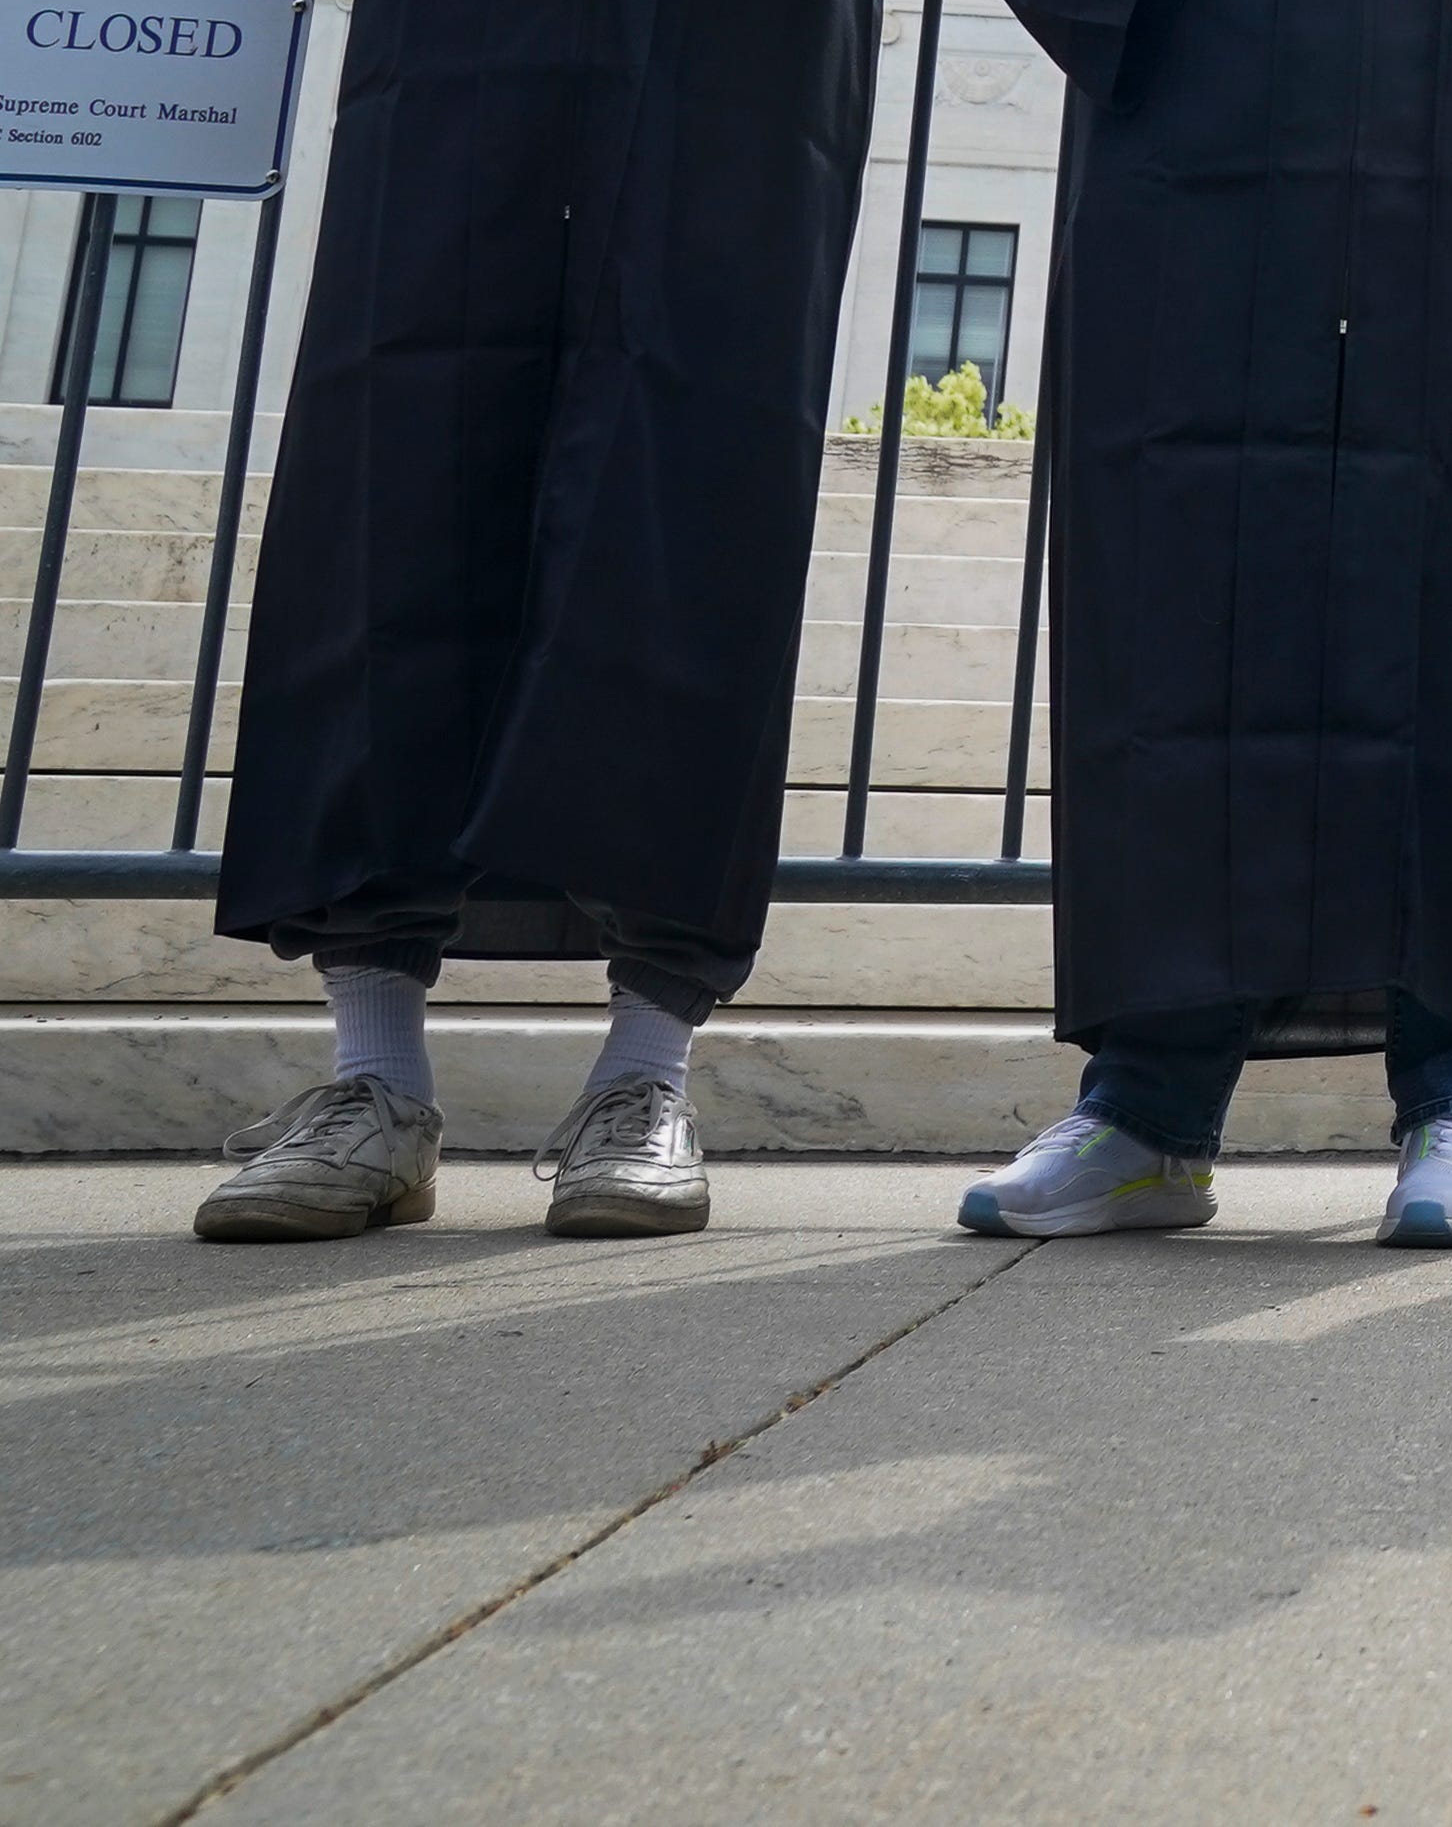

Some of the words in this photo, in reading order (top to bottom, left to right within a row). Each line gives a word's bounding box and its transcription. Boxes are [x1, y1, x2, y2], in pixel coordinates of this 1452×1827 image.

[26, 9, 243, 58] CLOSED
[89, 98, 147, 120] Court
[157, 102, 237, 125] Marshal
[8, 128, 63, 144] Section
[71, 132, 102, 146] 6102
